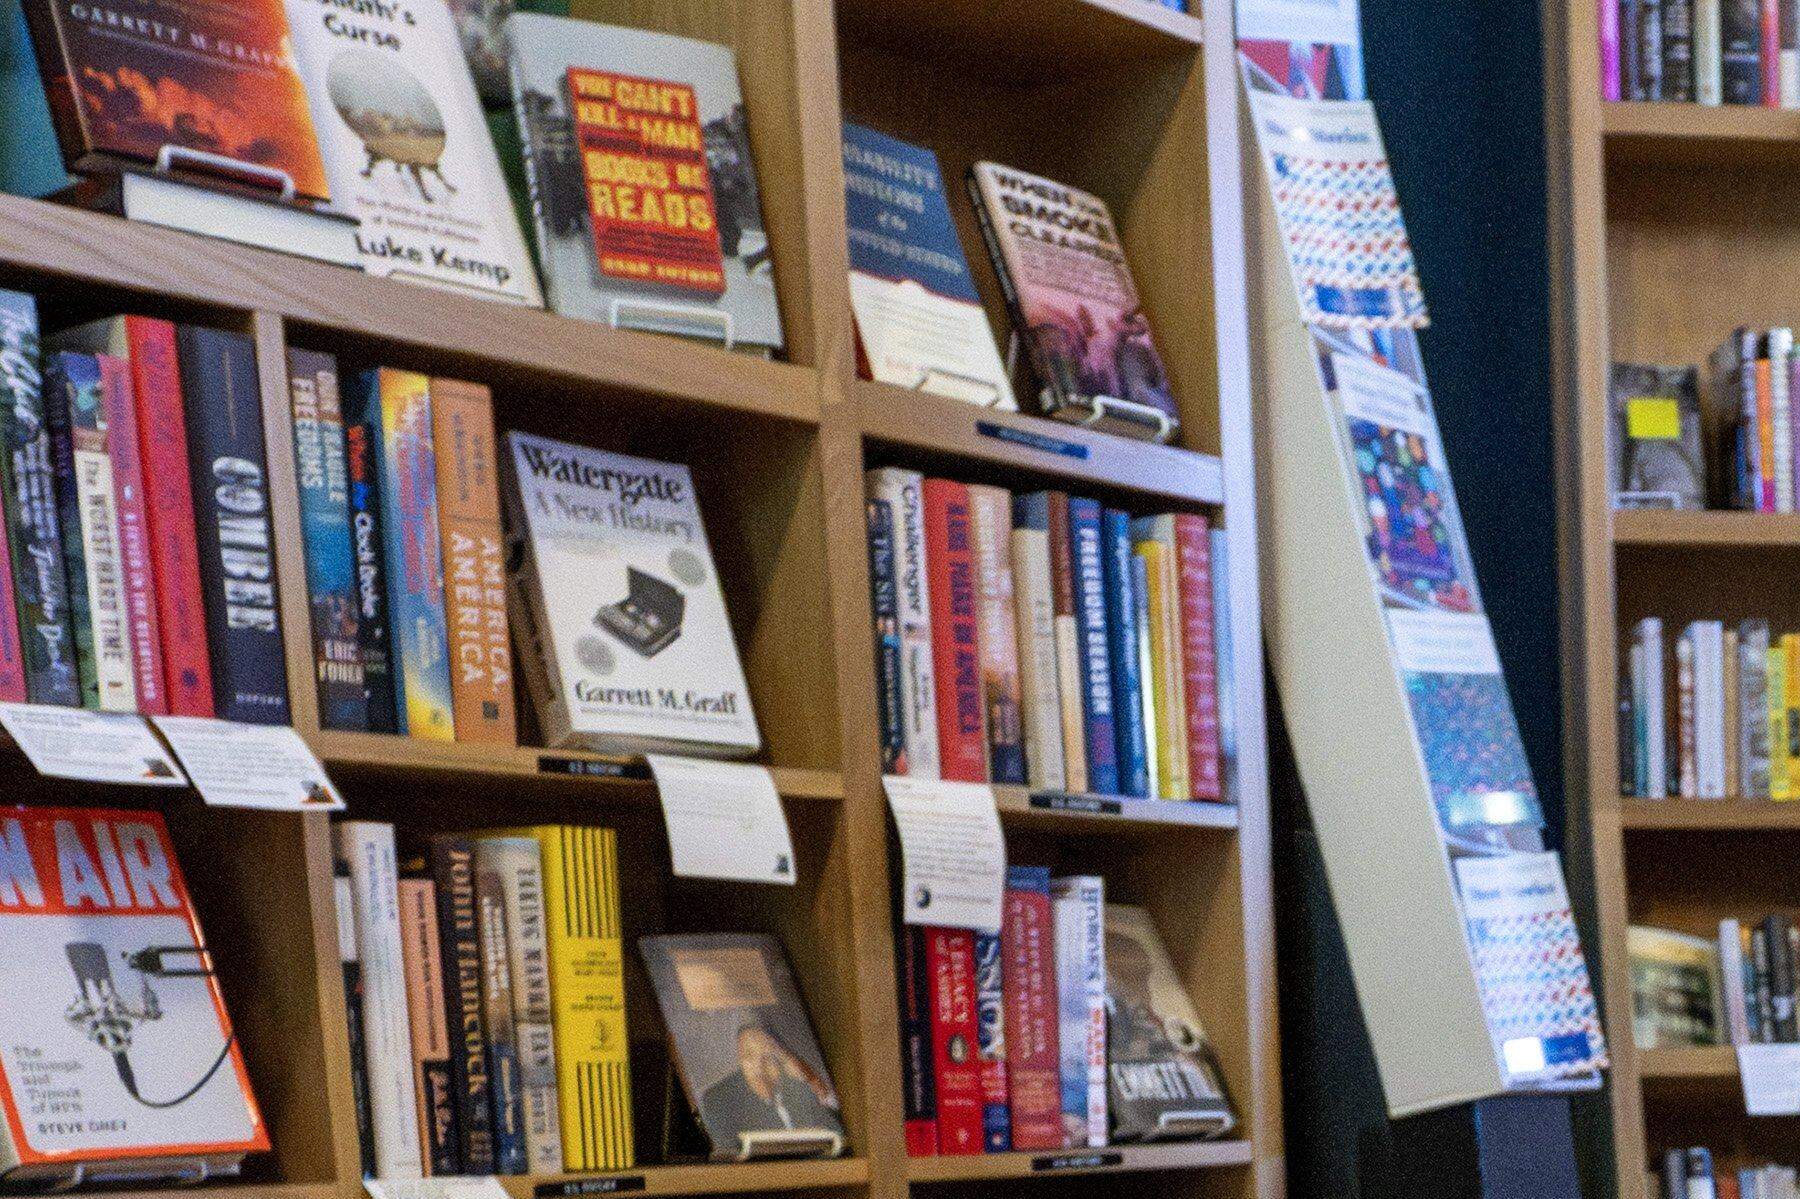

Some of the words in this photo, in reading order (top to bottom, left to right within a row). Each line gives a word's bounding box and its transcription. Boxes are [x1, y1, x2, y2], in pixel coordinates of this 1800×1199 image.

[70, 3, 180, 43] GARRETT
[322, 13, 402, 52] Curse
[615, 80, 694, 118] CAN'T
[640, 118, 701, 151] MAN
[588, 181, 712, 232] READS
[1001, 194, 1113, 245] SMOKE
[354, 232, 423, 264] Luke
[430, 246, 513, 286] Kemp
[293, 376, 324, 489] FREEDOMS
[519, 442, 686, 507] Watergate
[605, 499, 694, 541] History
[900, 483, 924, 618] Challenger
[97, 561, 119, 610] HARD
[1079, 527, 1105, 629] FREEDOM
[101, 617, 124, 660] TIME
[573, 680, 650, 709] Garrett
[685, 688, 740, 715] Graff
[1086, 632, 1112, 716] SEASON
[0, 818, 46, 906] N
[53, 818, 182, 909] AIR
[448, 849, 473, 931] John
[460, 941, 489, 1096] Hancock
[37, 1120, 85, 1135] STEVE
